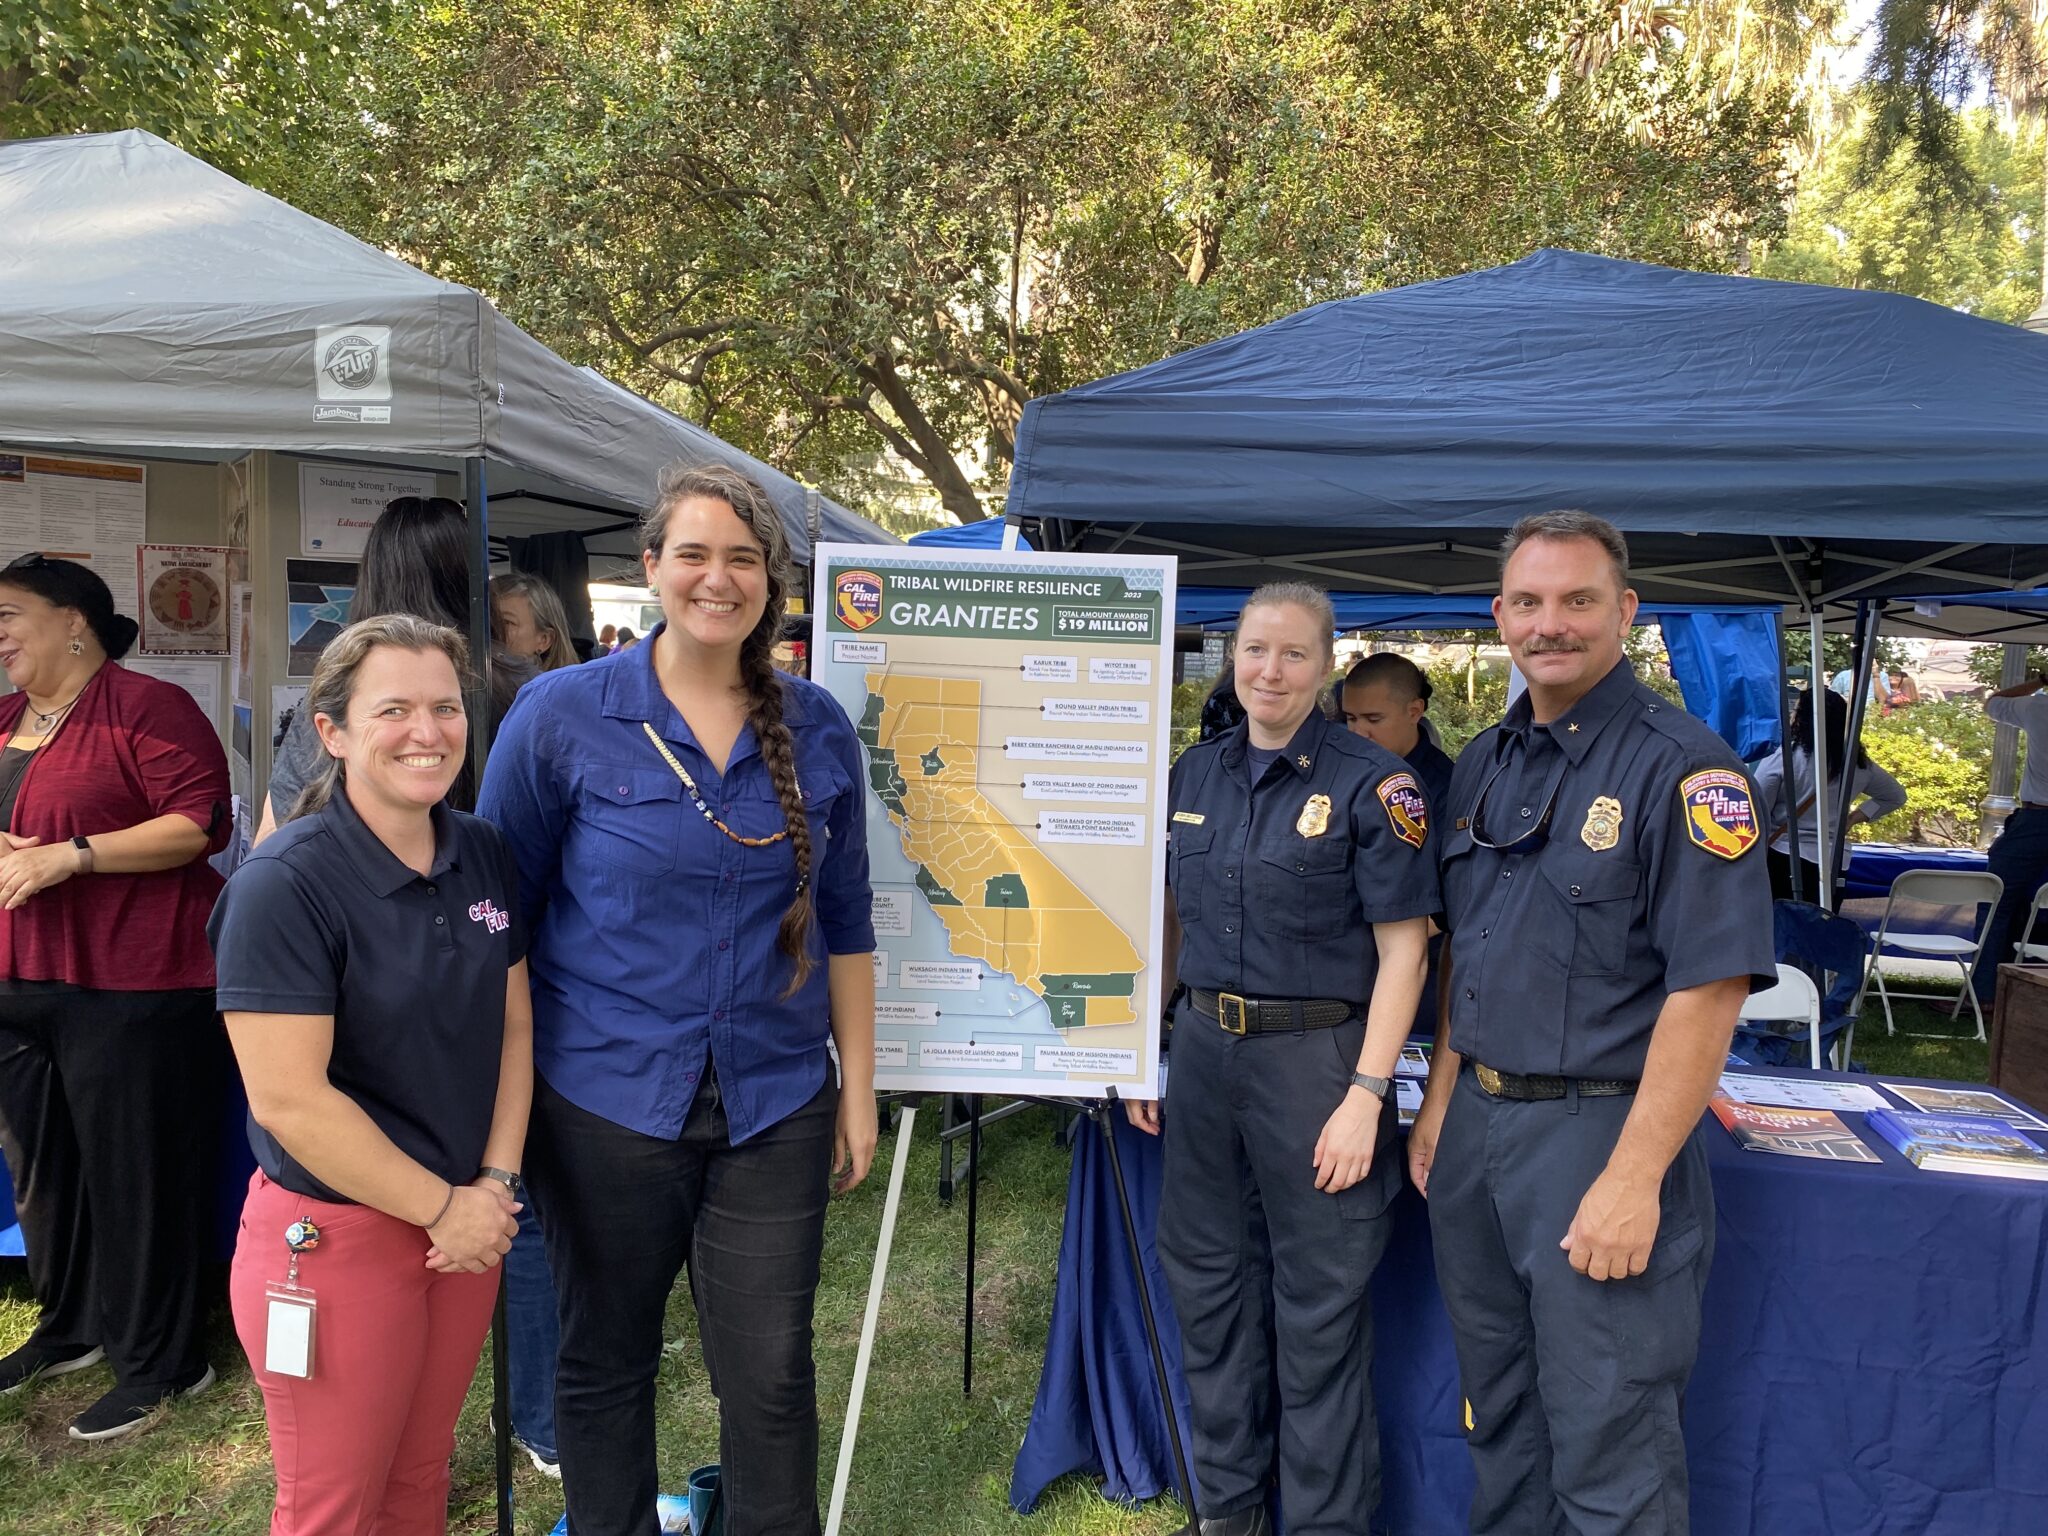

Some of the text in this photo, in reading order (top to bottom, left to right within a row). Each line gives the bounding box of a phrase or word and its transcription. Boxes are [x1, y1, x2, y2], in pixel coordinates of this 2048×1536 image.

[316, 407, 358, 418] Jamboree
[320, 477, 422, 494] Standing Strong Together
[351, 498, 372, 506] starts
[337, 517, 375, 529] Educatin
[843, 583, 866, 593] CAL
[889, 575, 939, 590] TRIBAL
[944, 578, 1014, 594] WILDFIRE
[1018, 581, 1102, 596] RESILIENCE
[853, 593, 880, 602] FIRE
[889, 602, 1039, 631] GRANTEES
[1058, 610, 1149, 620] TOTAL AMOUNT AWARDED
[1088, 619, 1148, 632] MILLION
[1391, 790, 1412, 804] CAL
[1695, 789, 1728, 803] CAL
[1404, 798, 1424, 812] FIRE
[1713, 801, 1749, 815] FIRE
[469, 899, 497, 921] CAL
[486, 911, 509, 934] FIR
